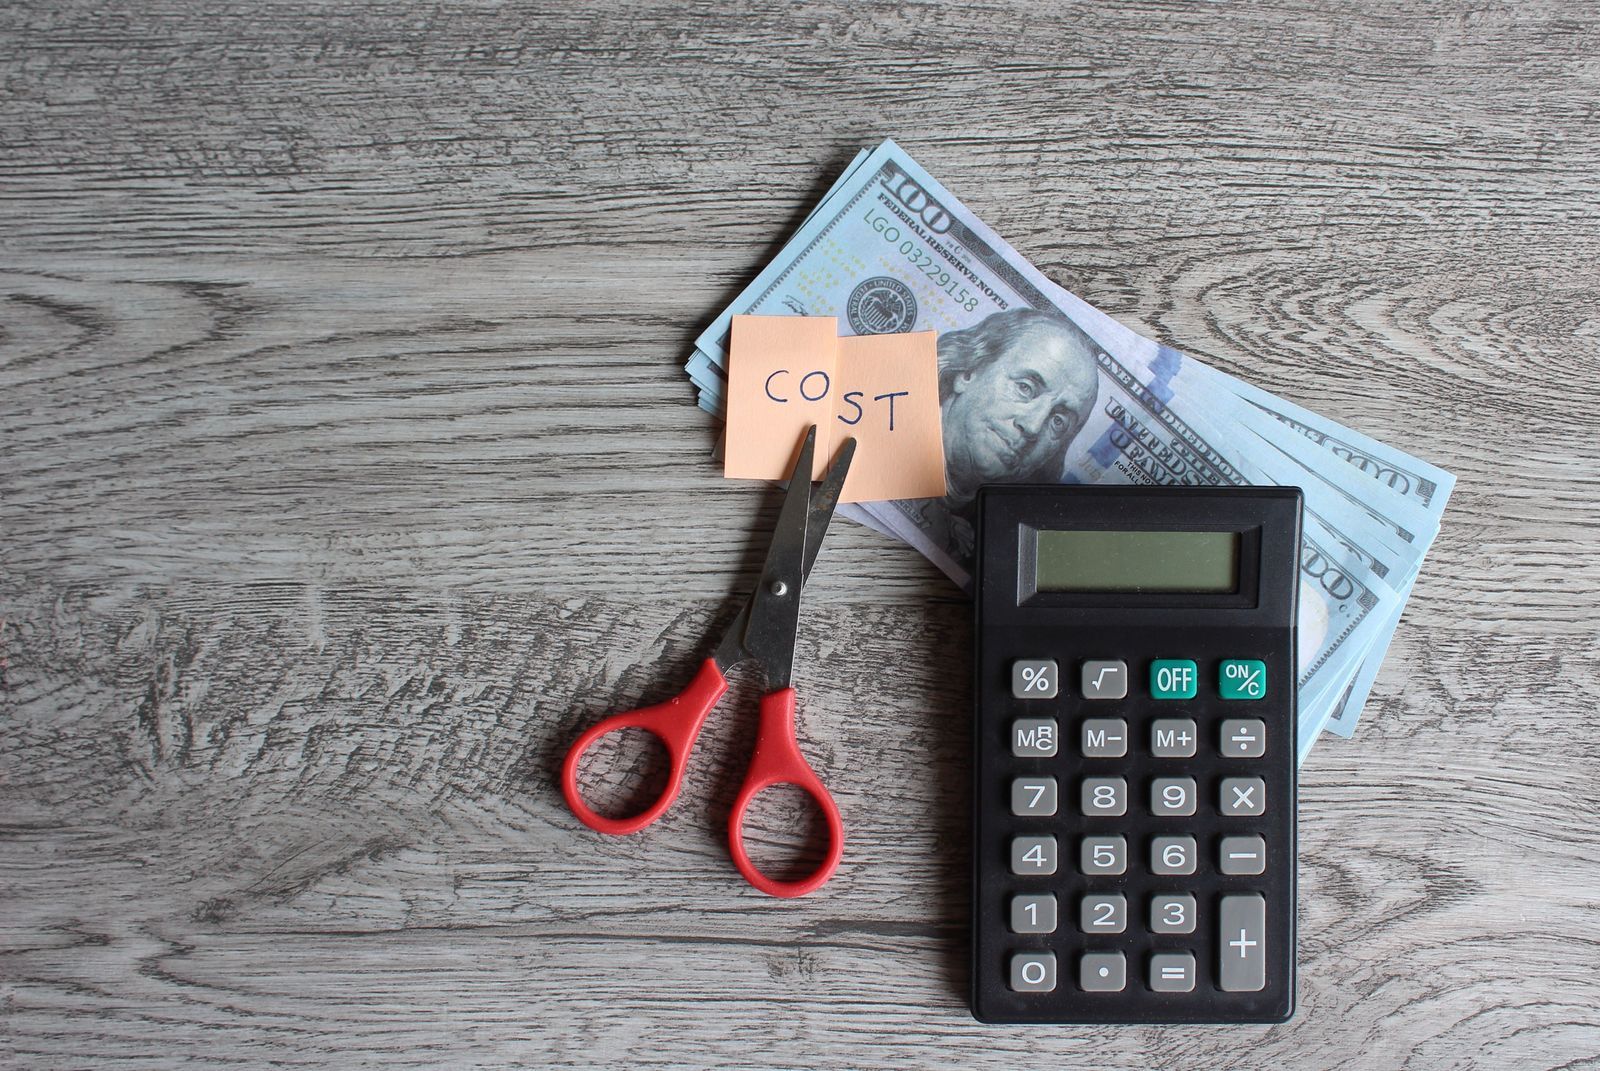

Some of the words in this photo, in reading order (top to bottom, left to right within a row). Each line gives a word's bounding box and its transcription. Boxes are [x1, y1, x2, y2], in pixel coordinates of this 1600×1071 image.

[880, 169, 951, 234] 100
[878, 192, 929, 240] FEDERAL
[926, 236, 979, 284] RESERVE
[976, 279, 1009, 311] NOTE
[899, 240, 979, 313] 03229158
[765, 370, 908, 431] COST
[1114, 460, 1128, 473] FOR
[1127, 461, 1142, 476] THIS
[1302, 540, 1354, 600] 00
[1157, 667, 1192, 692] OFF
[1157, 730, 1192, 747] M+
[1023, 786, 1046, 808] 7
[1092, 786, 1116, 808] 8
[1162, 786, 1186, 808] 9
[1022, 844, 1047, 867] 4
[1093, 845, 1116, 867] 5
[1162, 844, 1186, 867] 6
[1024, 903, 1037, 925] 1
[1093, 903, 1116, 925] 2
[1162, 903, 1185, 925] 3
[1021, 962, 1046, 984] 0
